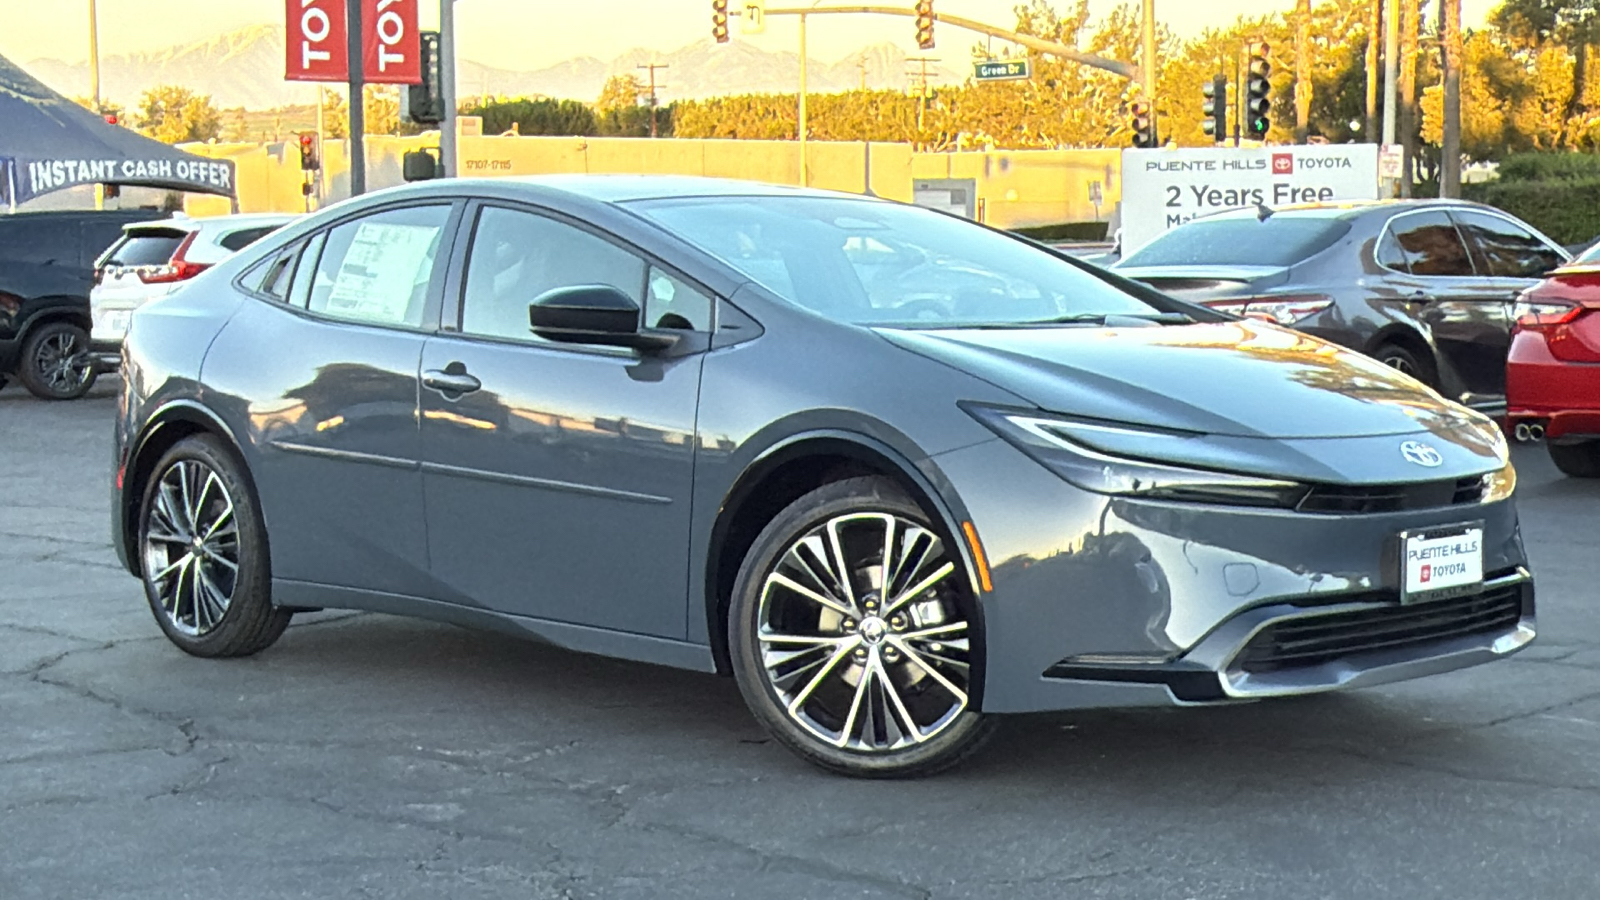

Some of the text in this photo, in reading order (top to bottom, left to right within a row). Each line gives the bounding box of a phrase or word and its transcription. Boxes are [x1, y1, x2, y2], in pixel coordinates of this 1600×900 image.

[981, 64, 1020, 76] Green Dr
[1146, 157, 1352, 172] PUENTE HILLS TOYOTA
[29, 160, 232, 194] INSTANT CASH OFFER
[1166, 183, 1334, 207] 2 Years Free
[1409, 541, 1478, 561] PUENTE HILLS
[1433, 562, 1467, 577] TOYOTA
